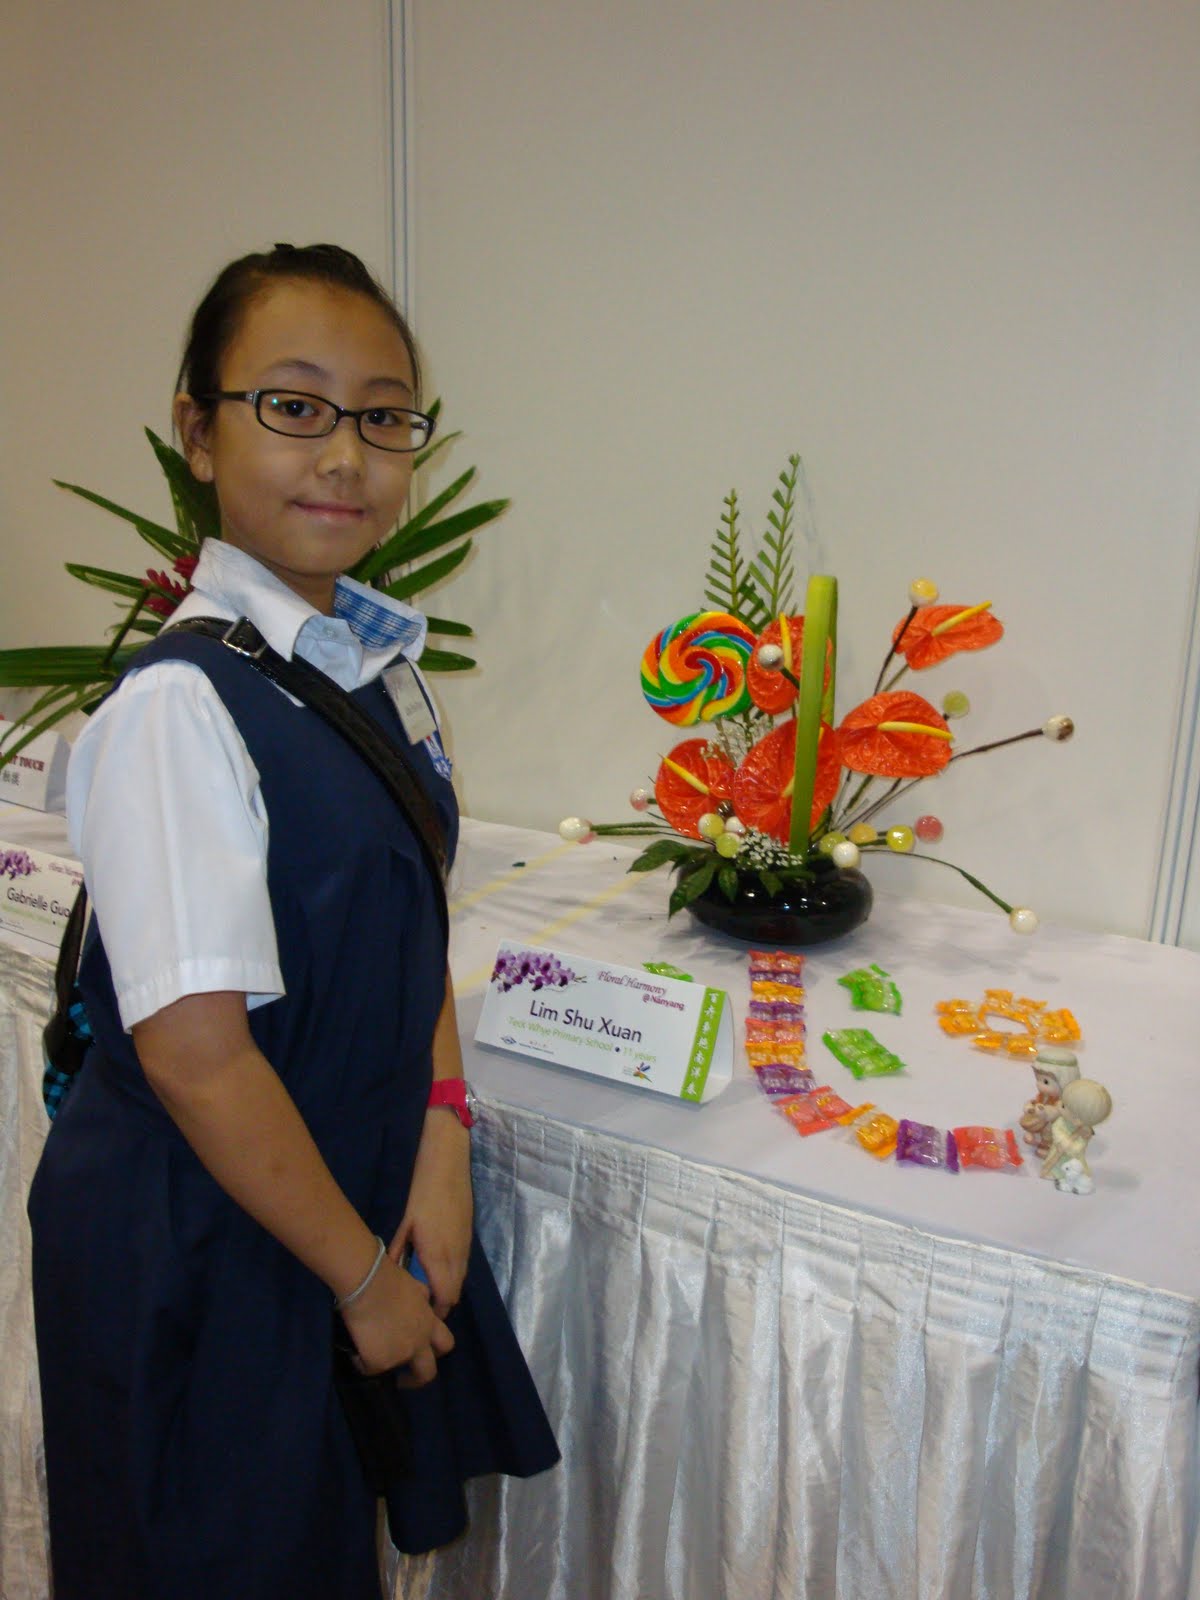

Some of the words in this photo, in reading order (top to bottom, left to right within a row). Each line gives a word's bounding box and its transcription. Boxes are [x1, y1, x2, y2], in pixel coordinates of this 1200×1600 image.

[7, 887, 48, 911] Gabrielle
[598, 970, 624, 985] Floral
[623, 974, 667, 996] Harmony
[529, 1000, 558, 1021] Lim
[562, 1008, 594, 1031] Shu
[598, 1016, 642, 1043] Xuan
[552, 1029, 584, 1045] Primary
[586, 1037, 613, 1052] School
[633, 1050, 657, 1063] years
